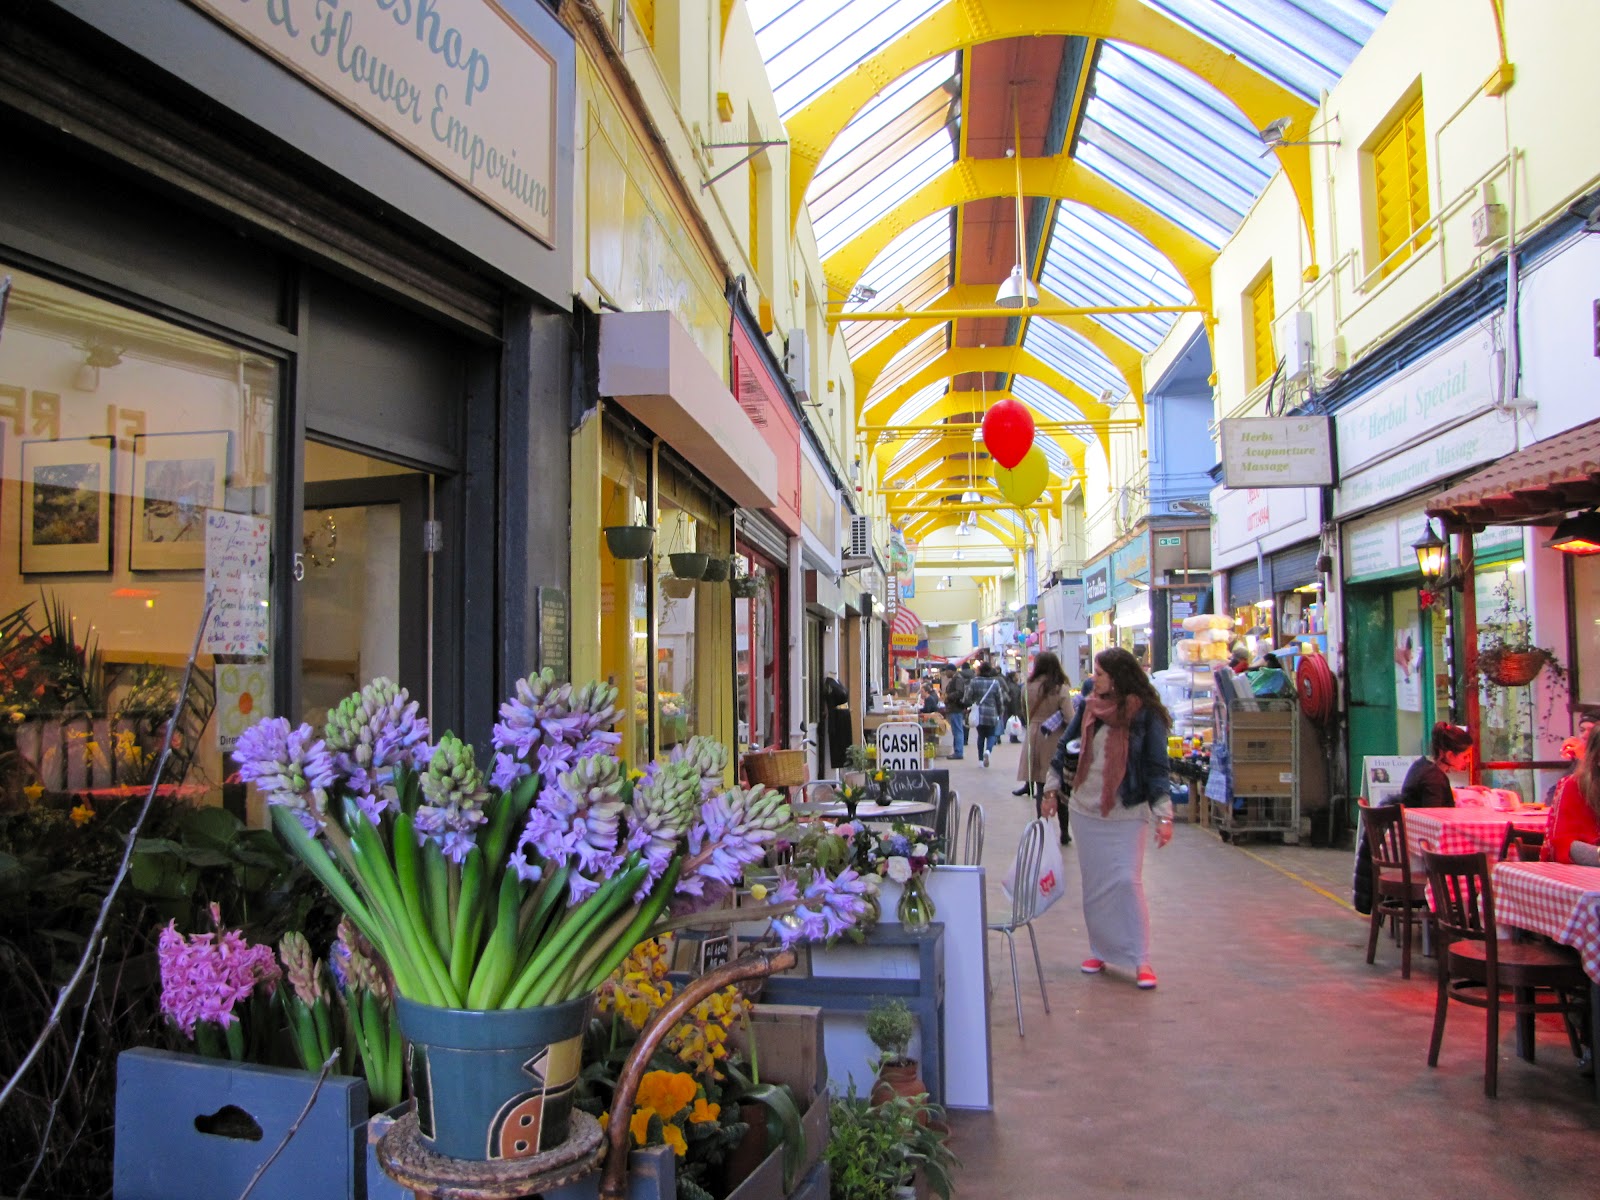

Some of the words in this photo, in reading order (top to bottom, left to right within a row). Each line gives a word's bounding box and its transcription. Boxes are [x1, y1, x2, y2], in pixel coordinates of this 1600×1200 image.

[376, 0, 490, 106] shop
[311, 0, 422, 125] Flower
[430, 83, 550, 217] Emporium
[1368, 395, 1408, 440] Herbal
[1415, 360, 1469, 420] Special
[1241, 432, 1273, 442] Herbs
[1242, 447, 1316, 458] Acupuncture
[1436, 437, 1479, 467] Massage
[1240, 462, 1290, 472] Massage
[293, 553, 304, 581] 5
[887, 575, 896, 614] HONEST
[881, 733, 918, 753] CASH
